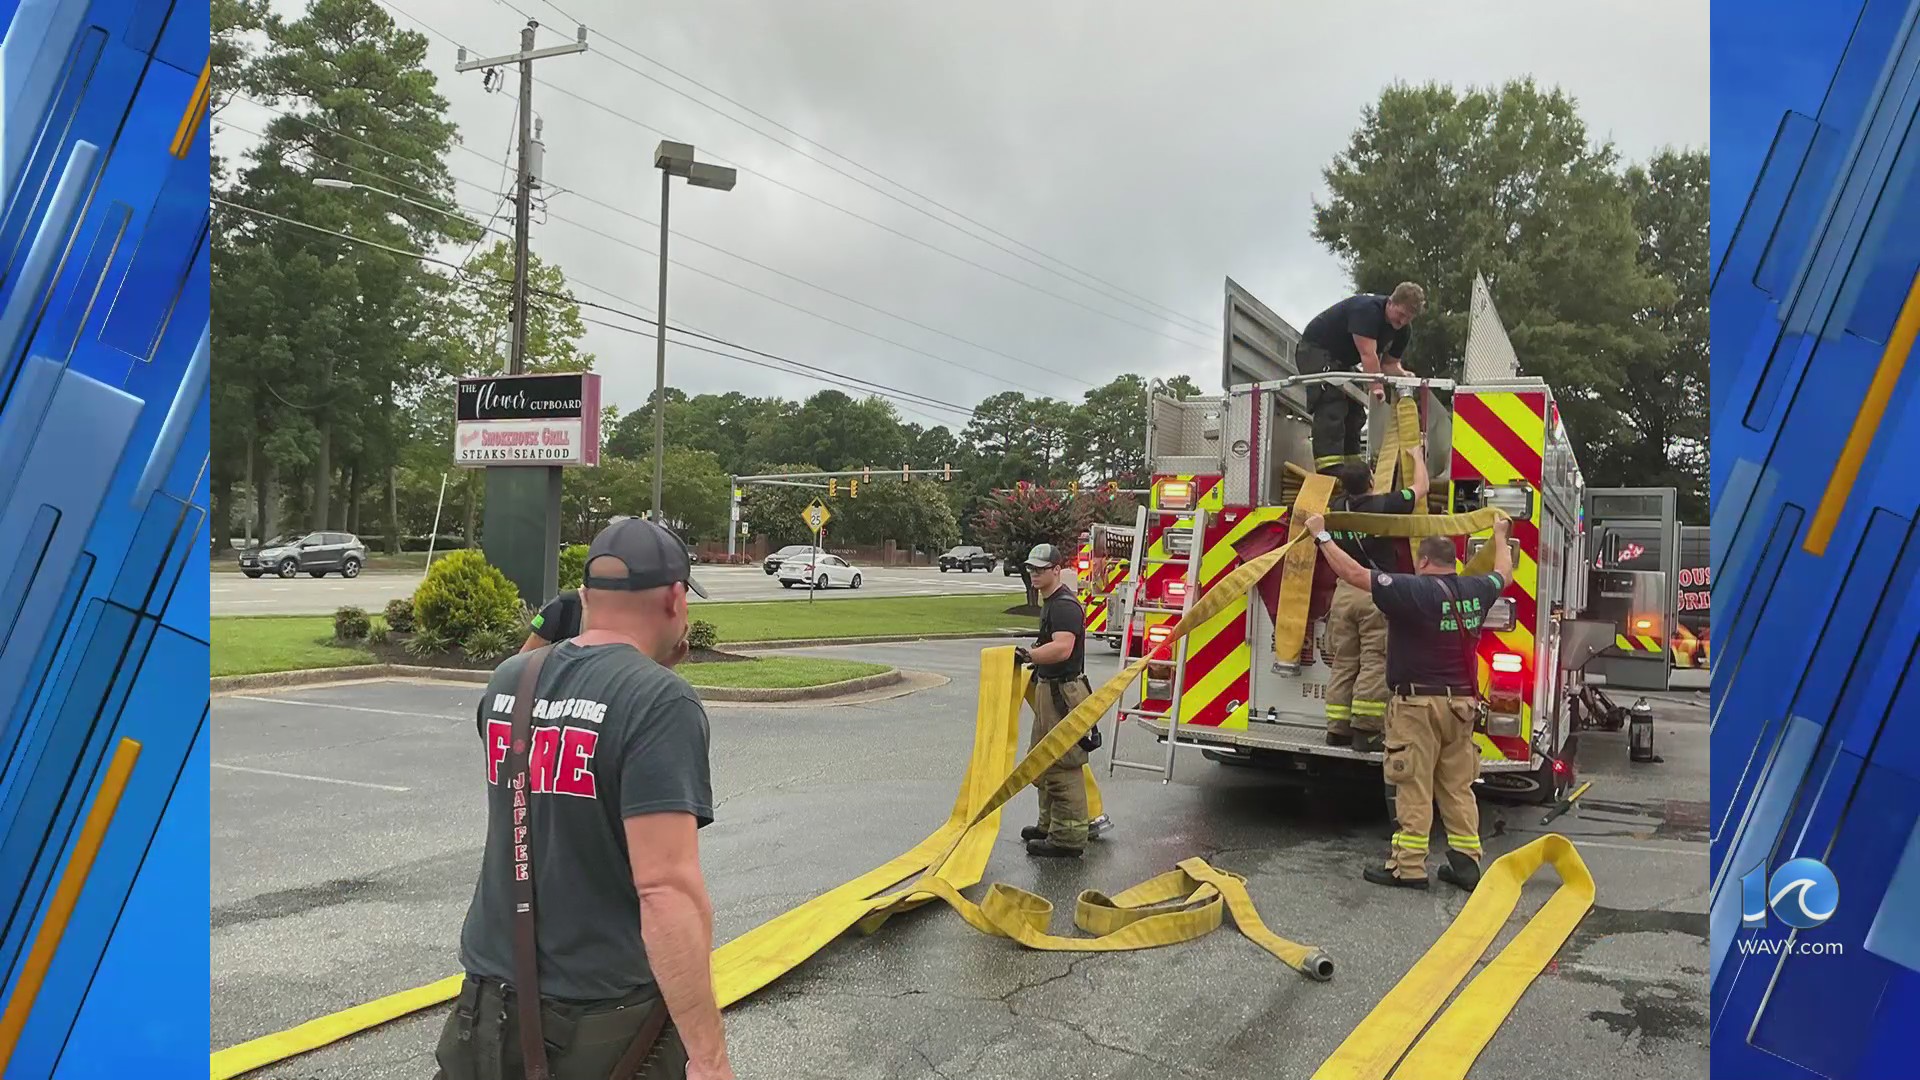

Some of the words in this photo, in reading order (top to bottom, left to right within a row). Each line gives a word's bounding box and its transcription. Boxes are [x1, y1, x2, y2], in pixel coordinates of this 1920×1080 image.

[461, 384, 477, 393] THE
[476, 382, 528, 419] flower
[530, 399, 582, 410] CUPBOARD
[462, 449, 506, 459] STEAKS
[514, 448, 570, 459] SEAFOOD
[811, 515, 821, 526] 25
[492, 693, 608, 724] WIAMSBURG
[487, 718, 599, 799] FRE
[513, 771, 529, 880] JAFFEE
